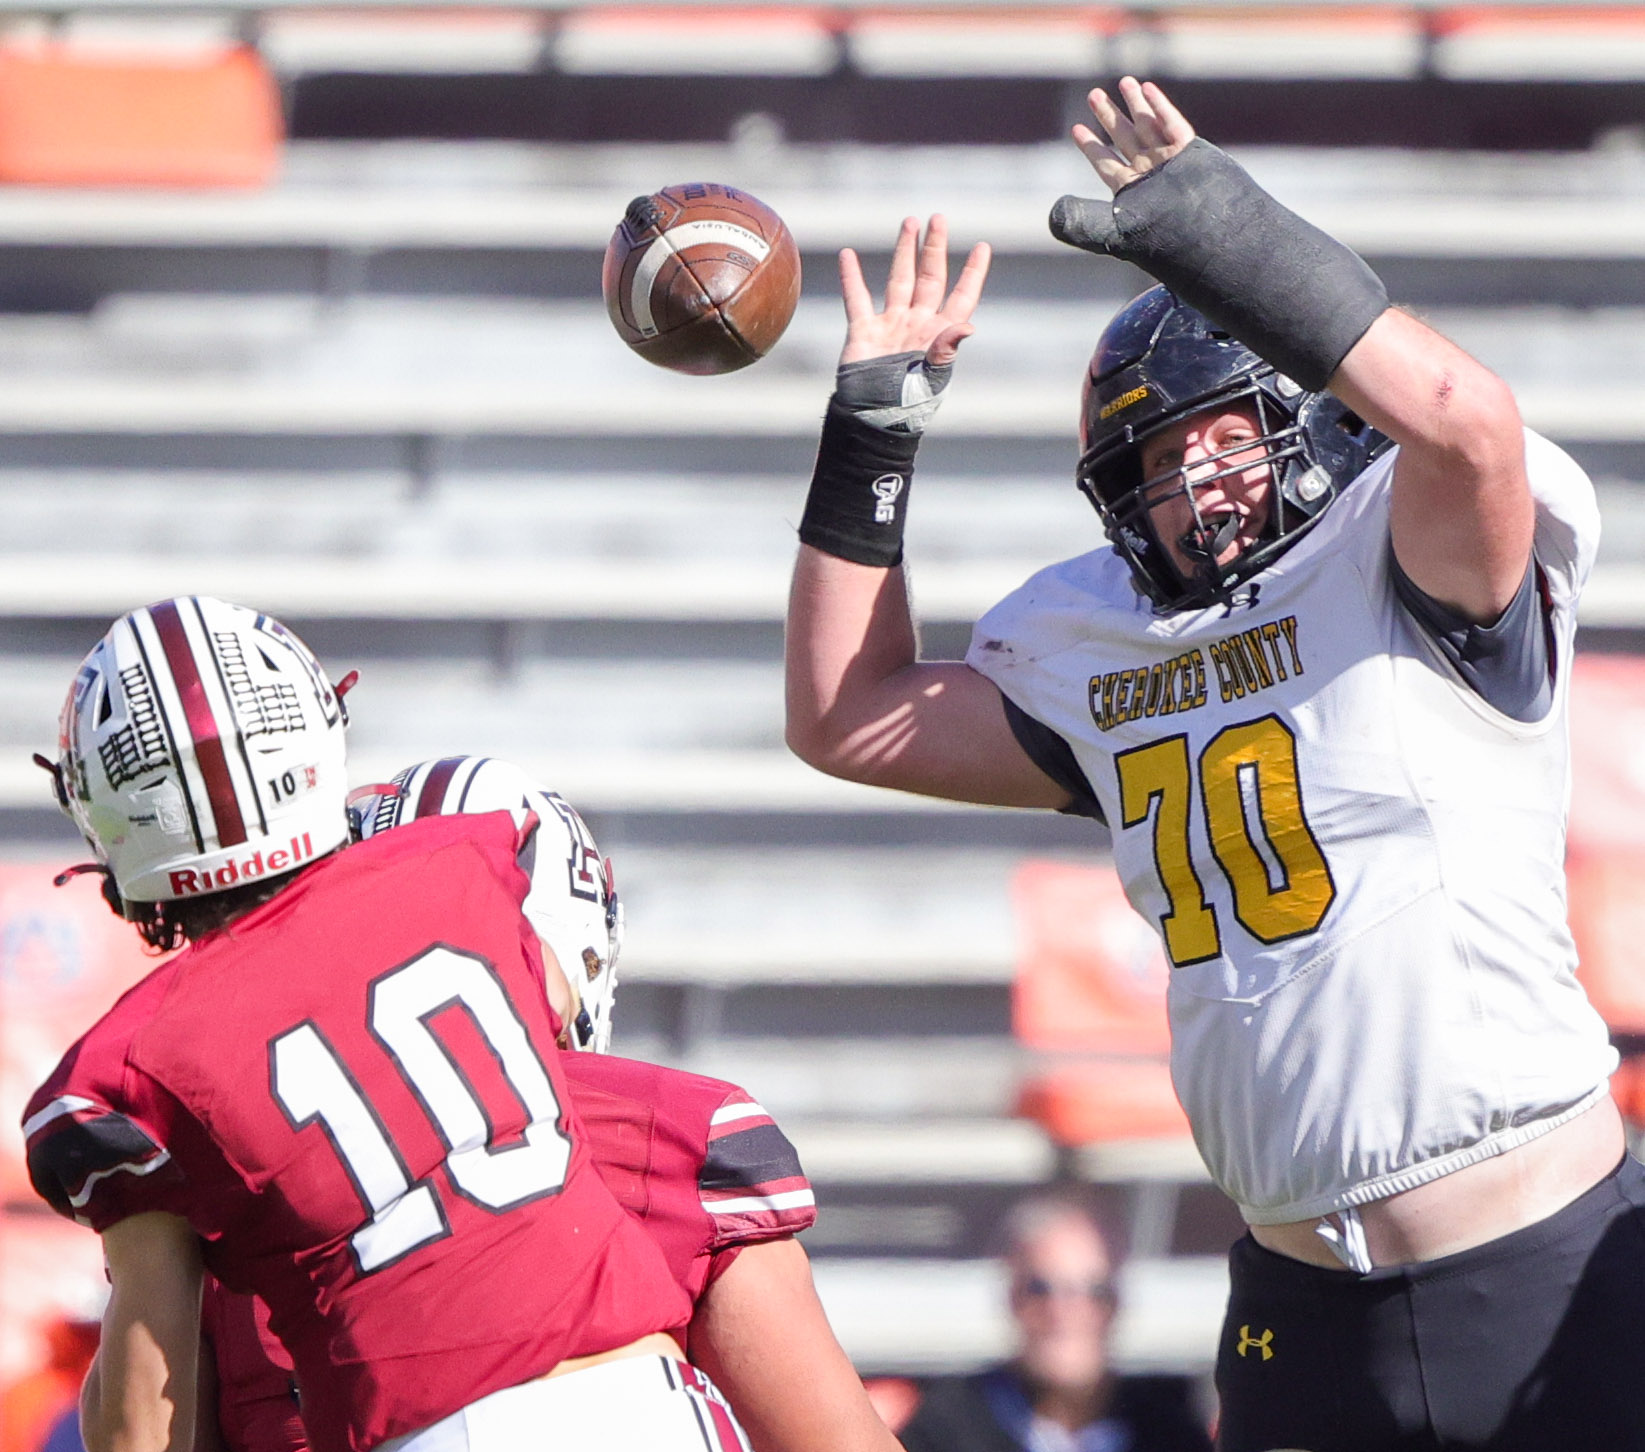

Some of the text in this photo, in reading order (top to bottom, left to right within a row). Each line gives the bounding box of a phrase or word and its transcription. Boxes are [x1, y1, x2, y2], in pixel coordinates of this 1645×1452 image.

[872, 473, 903, 523] TAG
[1089, 616, 1303, 731] CHEROKEE COUNTY
[268, 771, 296, 803] 10
[168, 833, 312, 896] Riddell
[1113, 713, 1337, 967] 70
[267, 941, 572, 1277] 10
